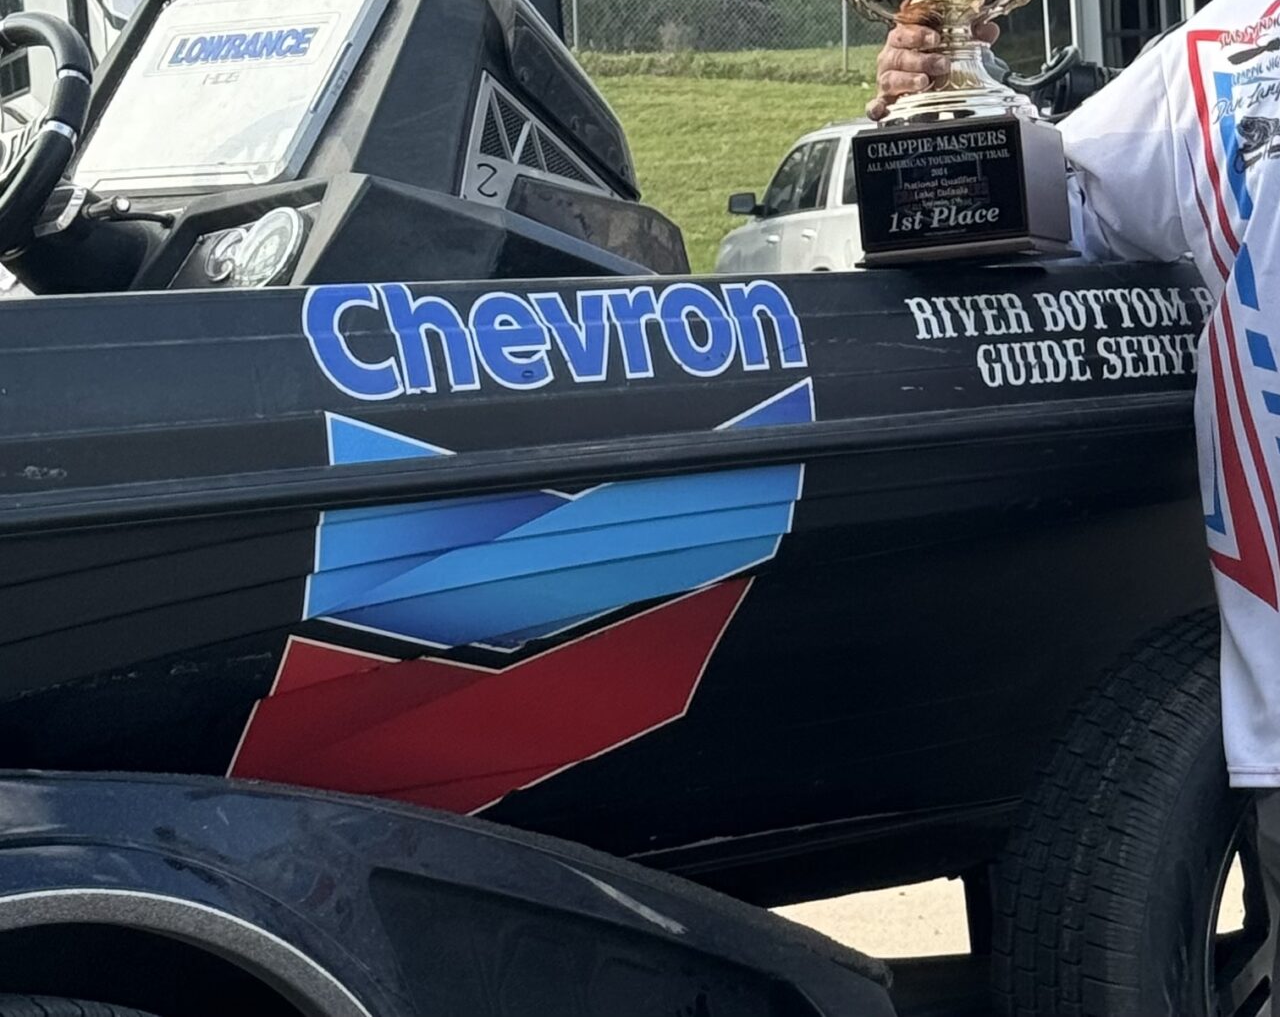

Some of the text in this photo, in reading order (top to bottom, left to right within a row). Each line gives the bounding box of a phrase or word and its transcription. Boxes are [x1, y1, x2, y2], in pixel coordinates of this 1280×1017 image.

[167, 27, 320, 67] LOWRANCE
[867, 129, 1007, 159] CRAPPIE MASTERS
[867, 163, 882, 172] ALL
[928, 151, 985, 165] TOURNAMENT
[986, 148, 1010, 160] TRAIL
[903, 175, 977, 190] National Qualifier
[889, 212, 923, 233] 1st
[930, 206, 1000, 229] Place
[905, 292, 1033, 339] RIVER
[1033, 287, 1191, 332] BOTTOM
[302, 280, 808, 400] Chevron
[976, 333, 1201, 387] GUIDE SERVI
